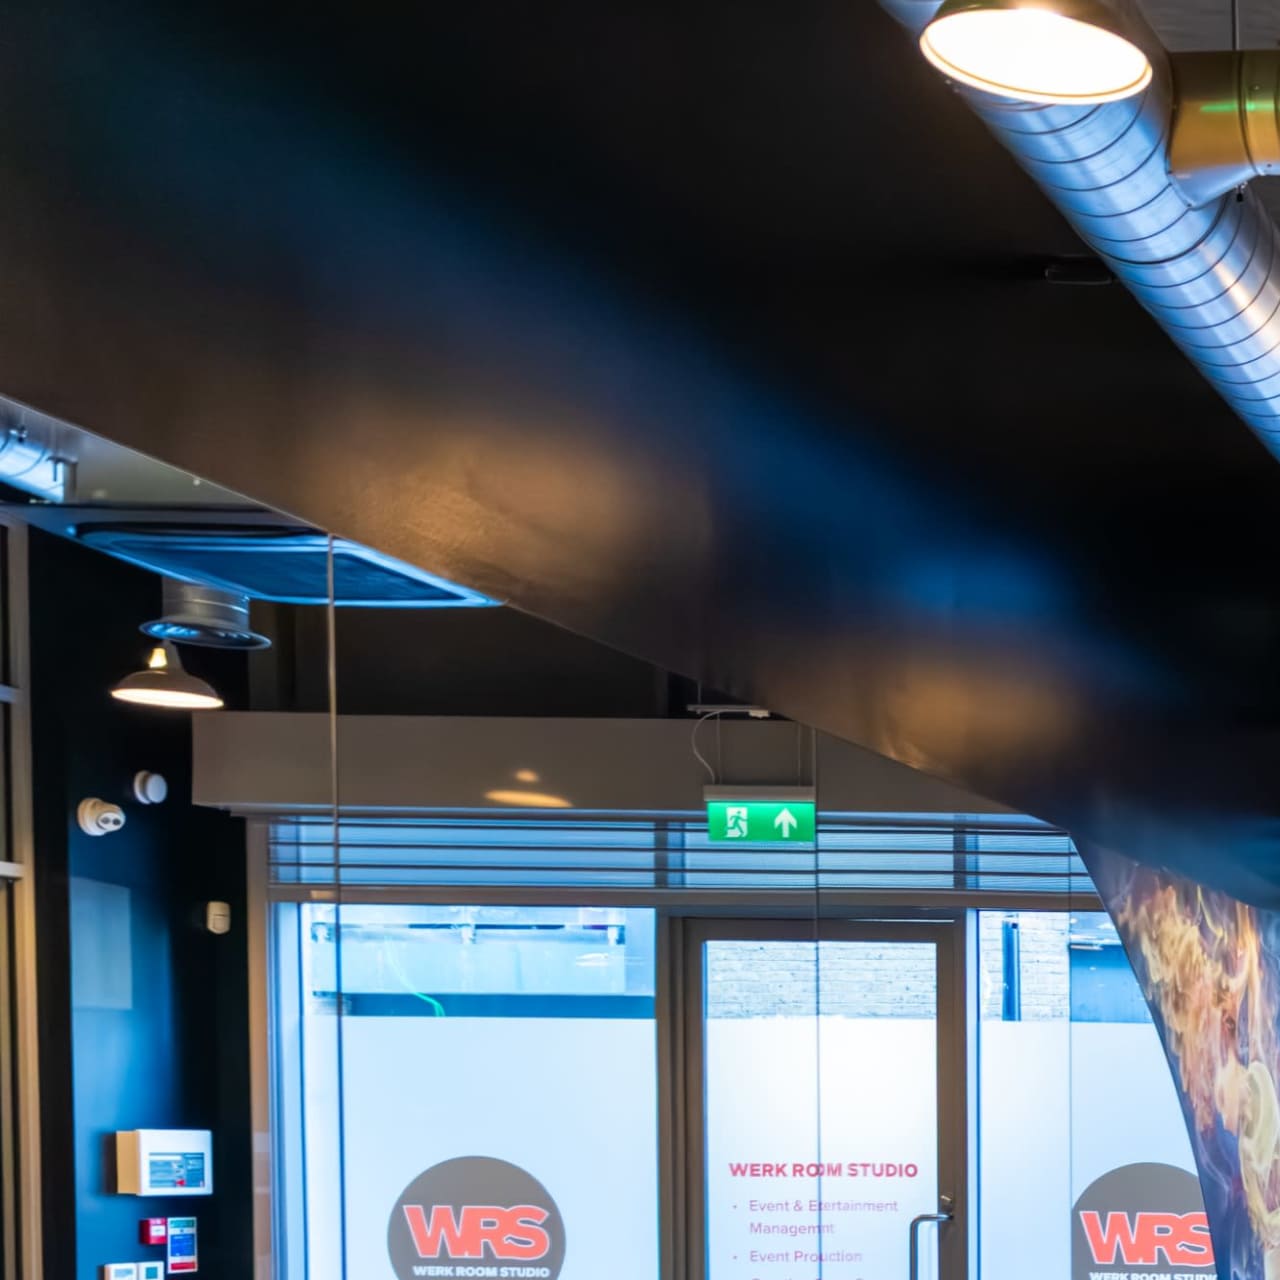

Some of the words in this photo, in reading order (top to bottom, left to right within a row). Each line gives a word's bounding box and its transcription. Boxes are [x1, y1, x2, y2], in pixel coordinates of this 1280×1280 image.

[729, 1162, 787, 1178] WERK
[847, 1162, 919, 1178] STUDIO
[749, 1199, 790, 1213] Event
[793, 1199, 804, 1213] &
[403, 1204, 551, 1261] WRS
[1079, 1211, 1216, 1267] WRS
[749, 1250, 790, 1263] Event
[412, 1265, 454, 1277] WERK
[455, 1266, 498, 1277] ROOM
[500, 1267, 550, 1278] STUDIO
